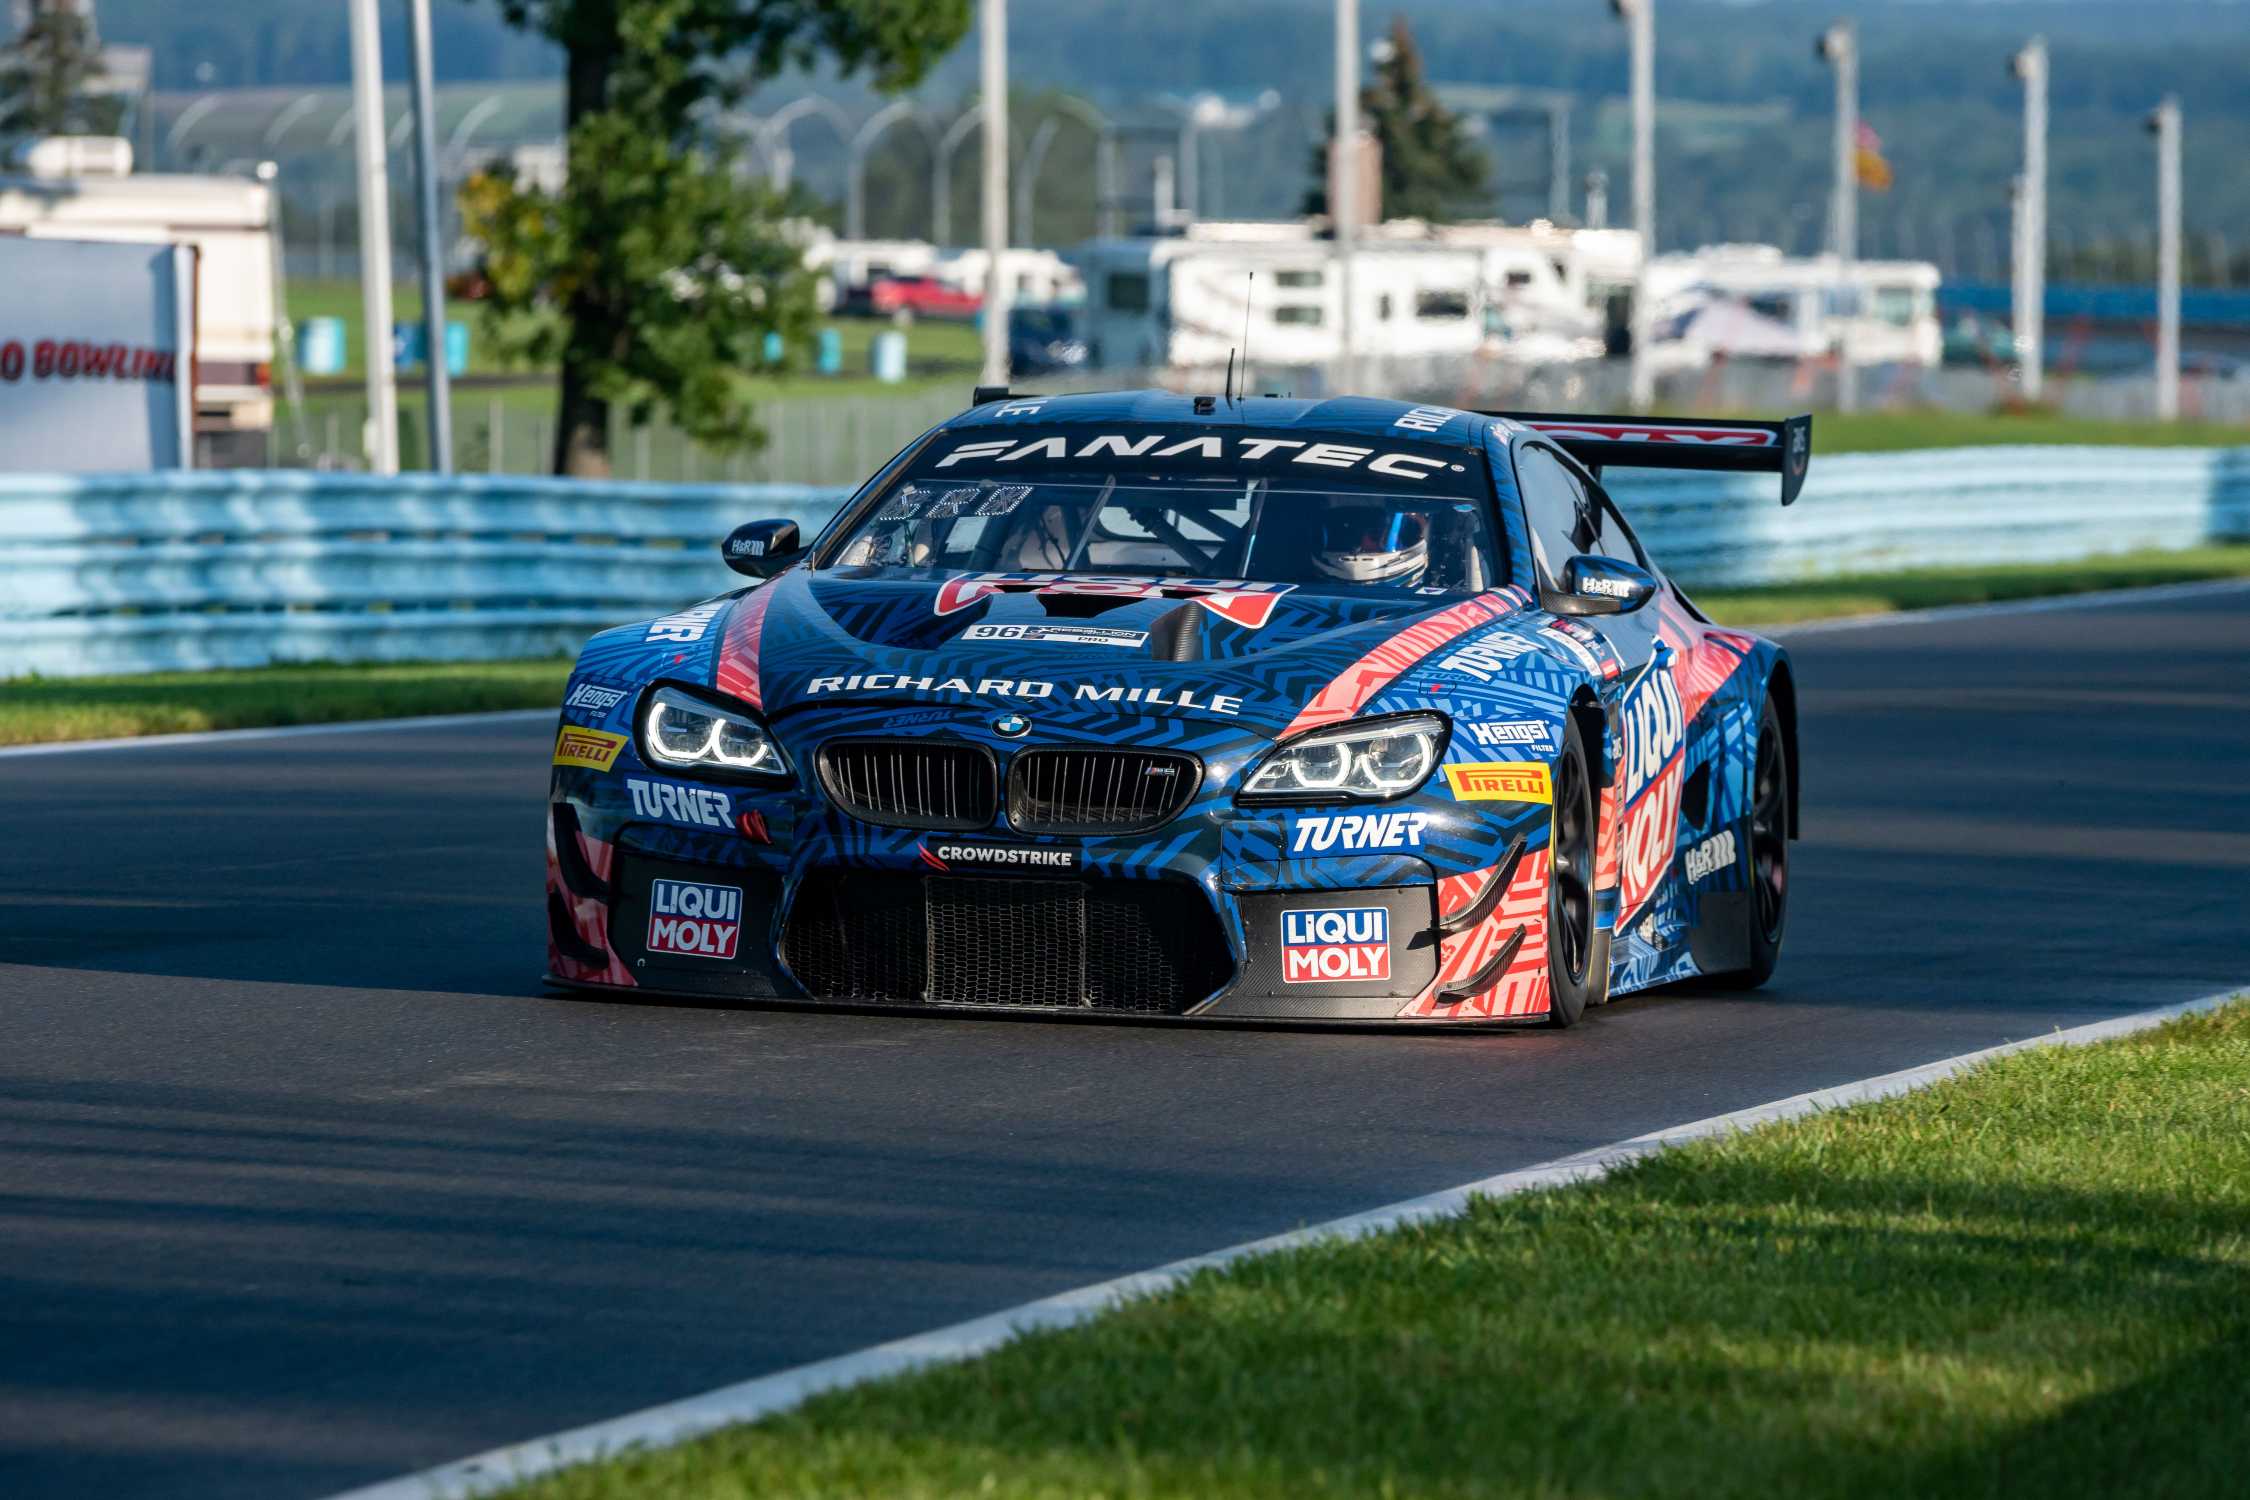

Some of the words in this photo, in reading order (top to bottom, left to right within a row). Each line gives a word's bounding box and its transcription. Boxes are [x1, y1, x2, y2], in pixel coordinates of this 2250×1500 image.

[934, 435, 1448, 480] FANATEC
[975, 626, 1022, 639] 96
[565, 683, 628, 709] Hengst
[806, 674, 1054, 699] RICHARD
[1074, 684, 1244, 715] MILLE
[559, 732, 618, 763] PIRELLI
[1468, 719, 1550, 745] Hengst
[1531, 744, 1554, 753] FILTER
[1456, 769, 1545, 795] PIRELLI
[626, 779, 736, 830] TURNER
[1293, 812, 1431, 852] TURNER
[937, 845, 1073, 867] CROWDSTRIKE
[656, 883, 737, 920] LIQUI
[651, 918, 738, 954] MOLY
[1288, 911, 1383, 945] LIQUI
[1288, 946, 1386, 979] MOLY
